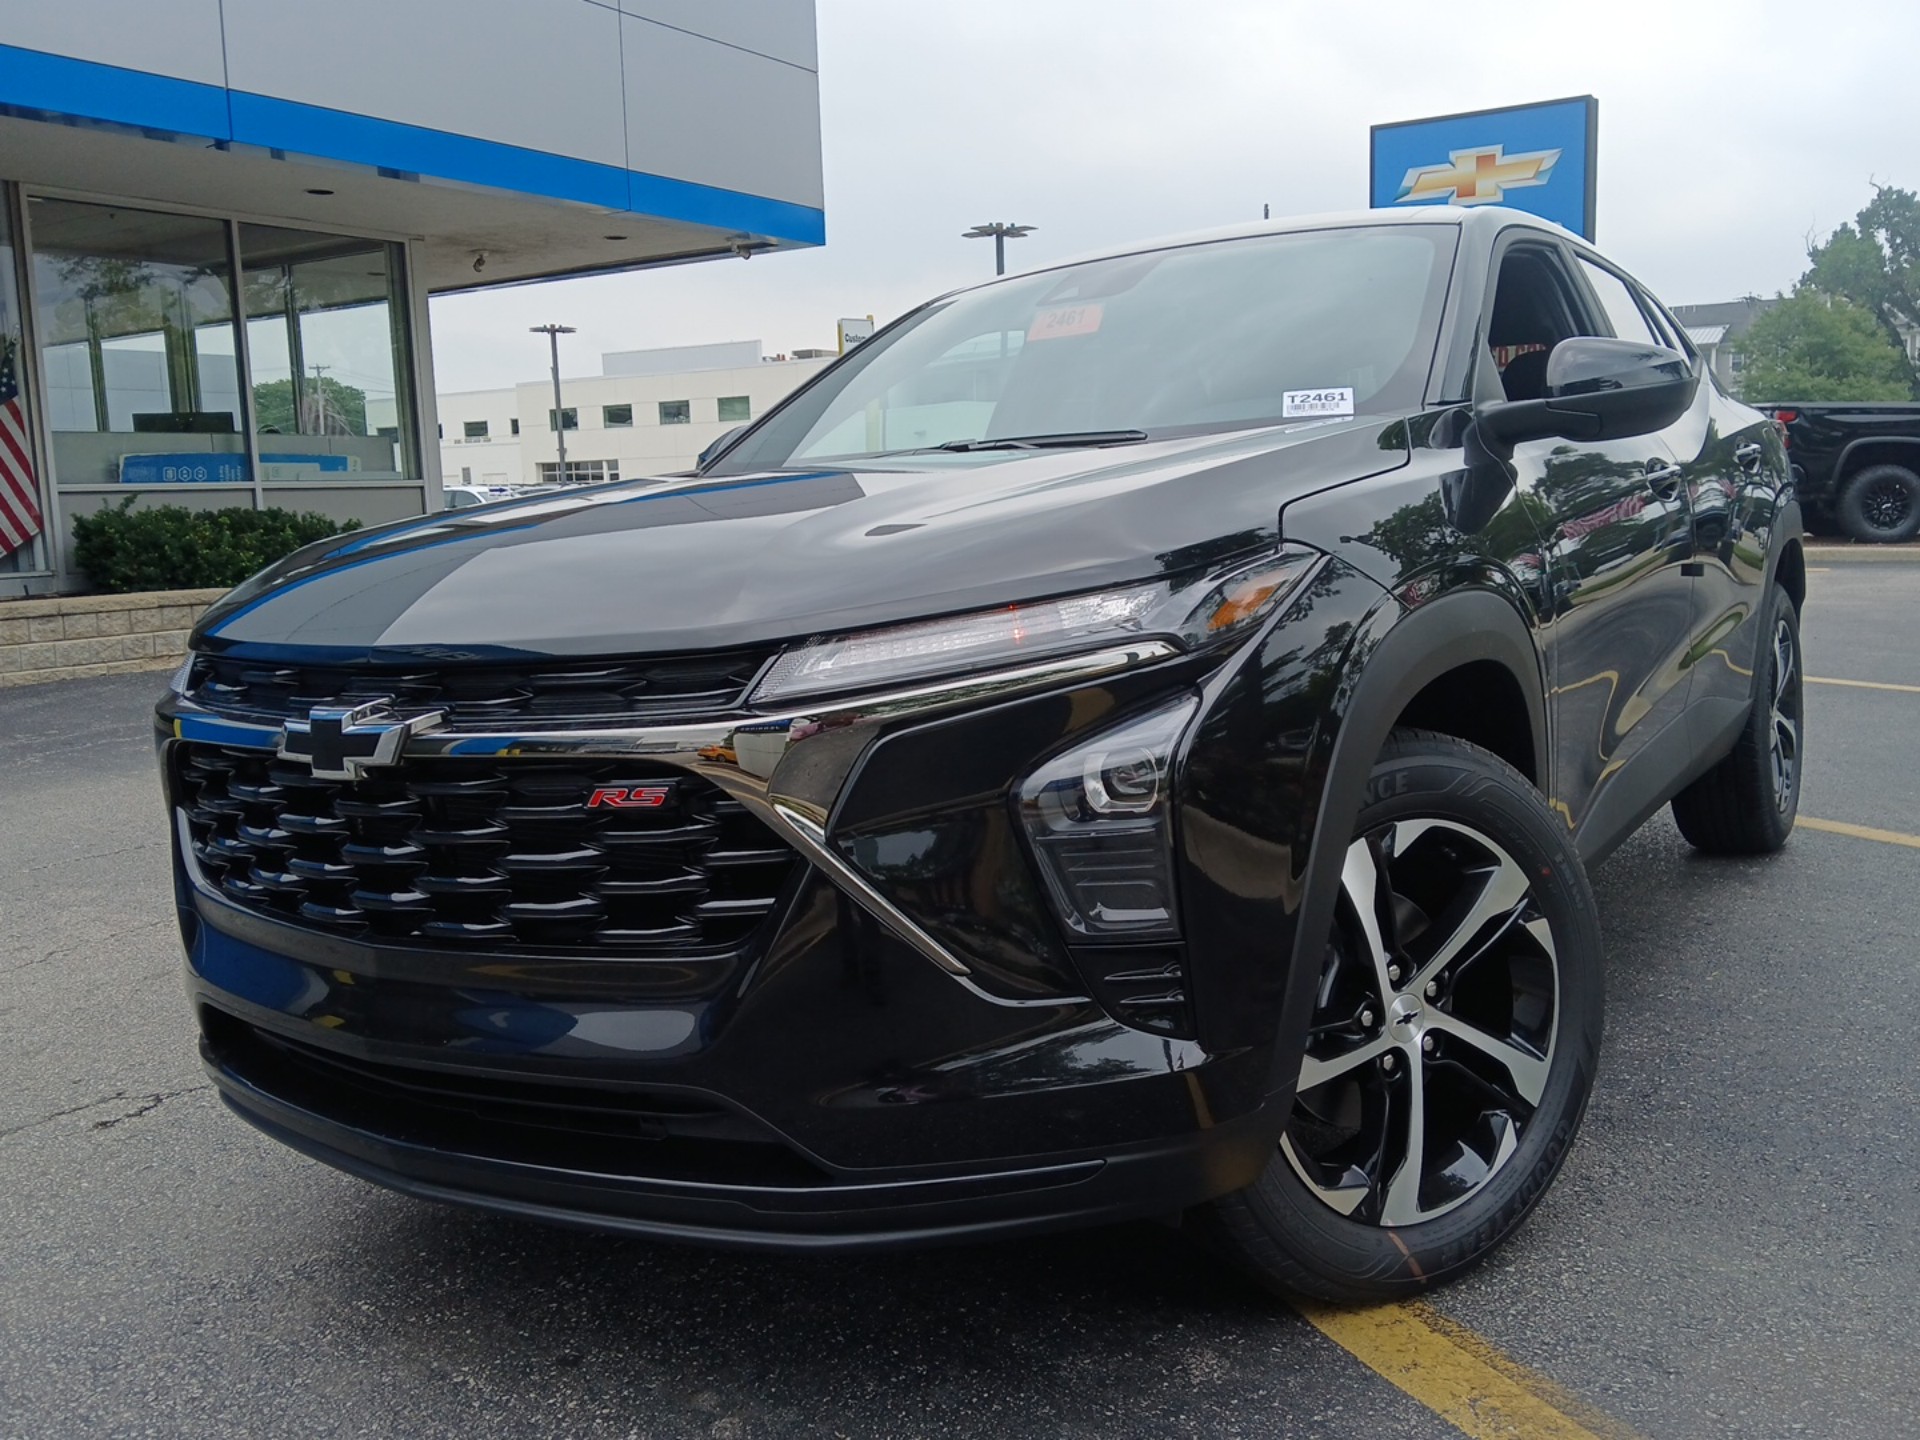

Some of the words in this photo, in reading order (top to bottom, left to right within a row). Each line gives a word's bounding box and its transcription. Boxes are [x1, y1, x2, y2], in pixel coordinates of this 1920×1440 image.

[1046, 308, 1086, 329] 2461
[1287, 392, 1347, 404] T2461
[587, 787, 669, 808] RS
